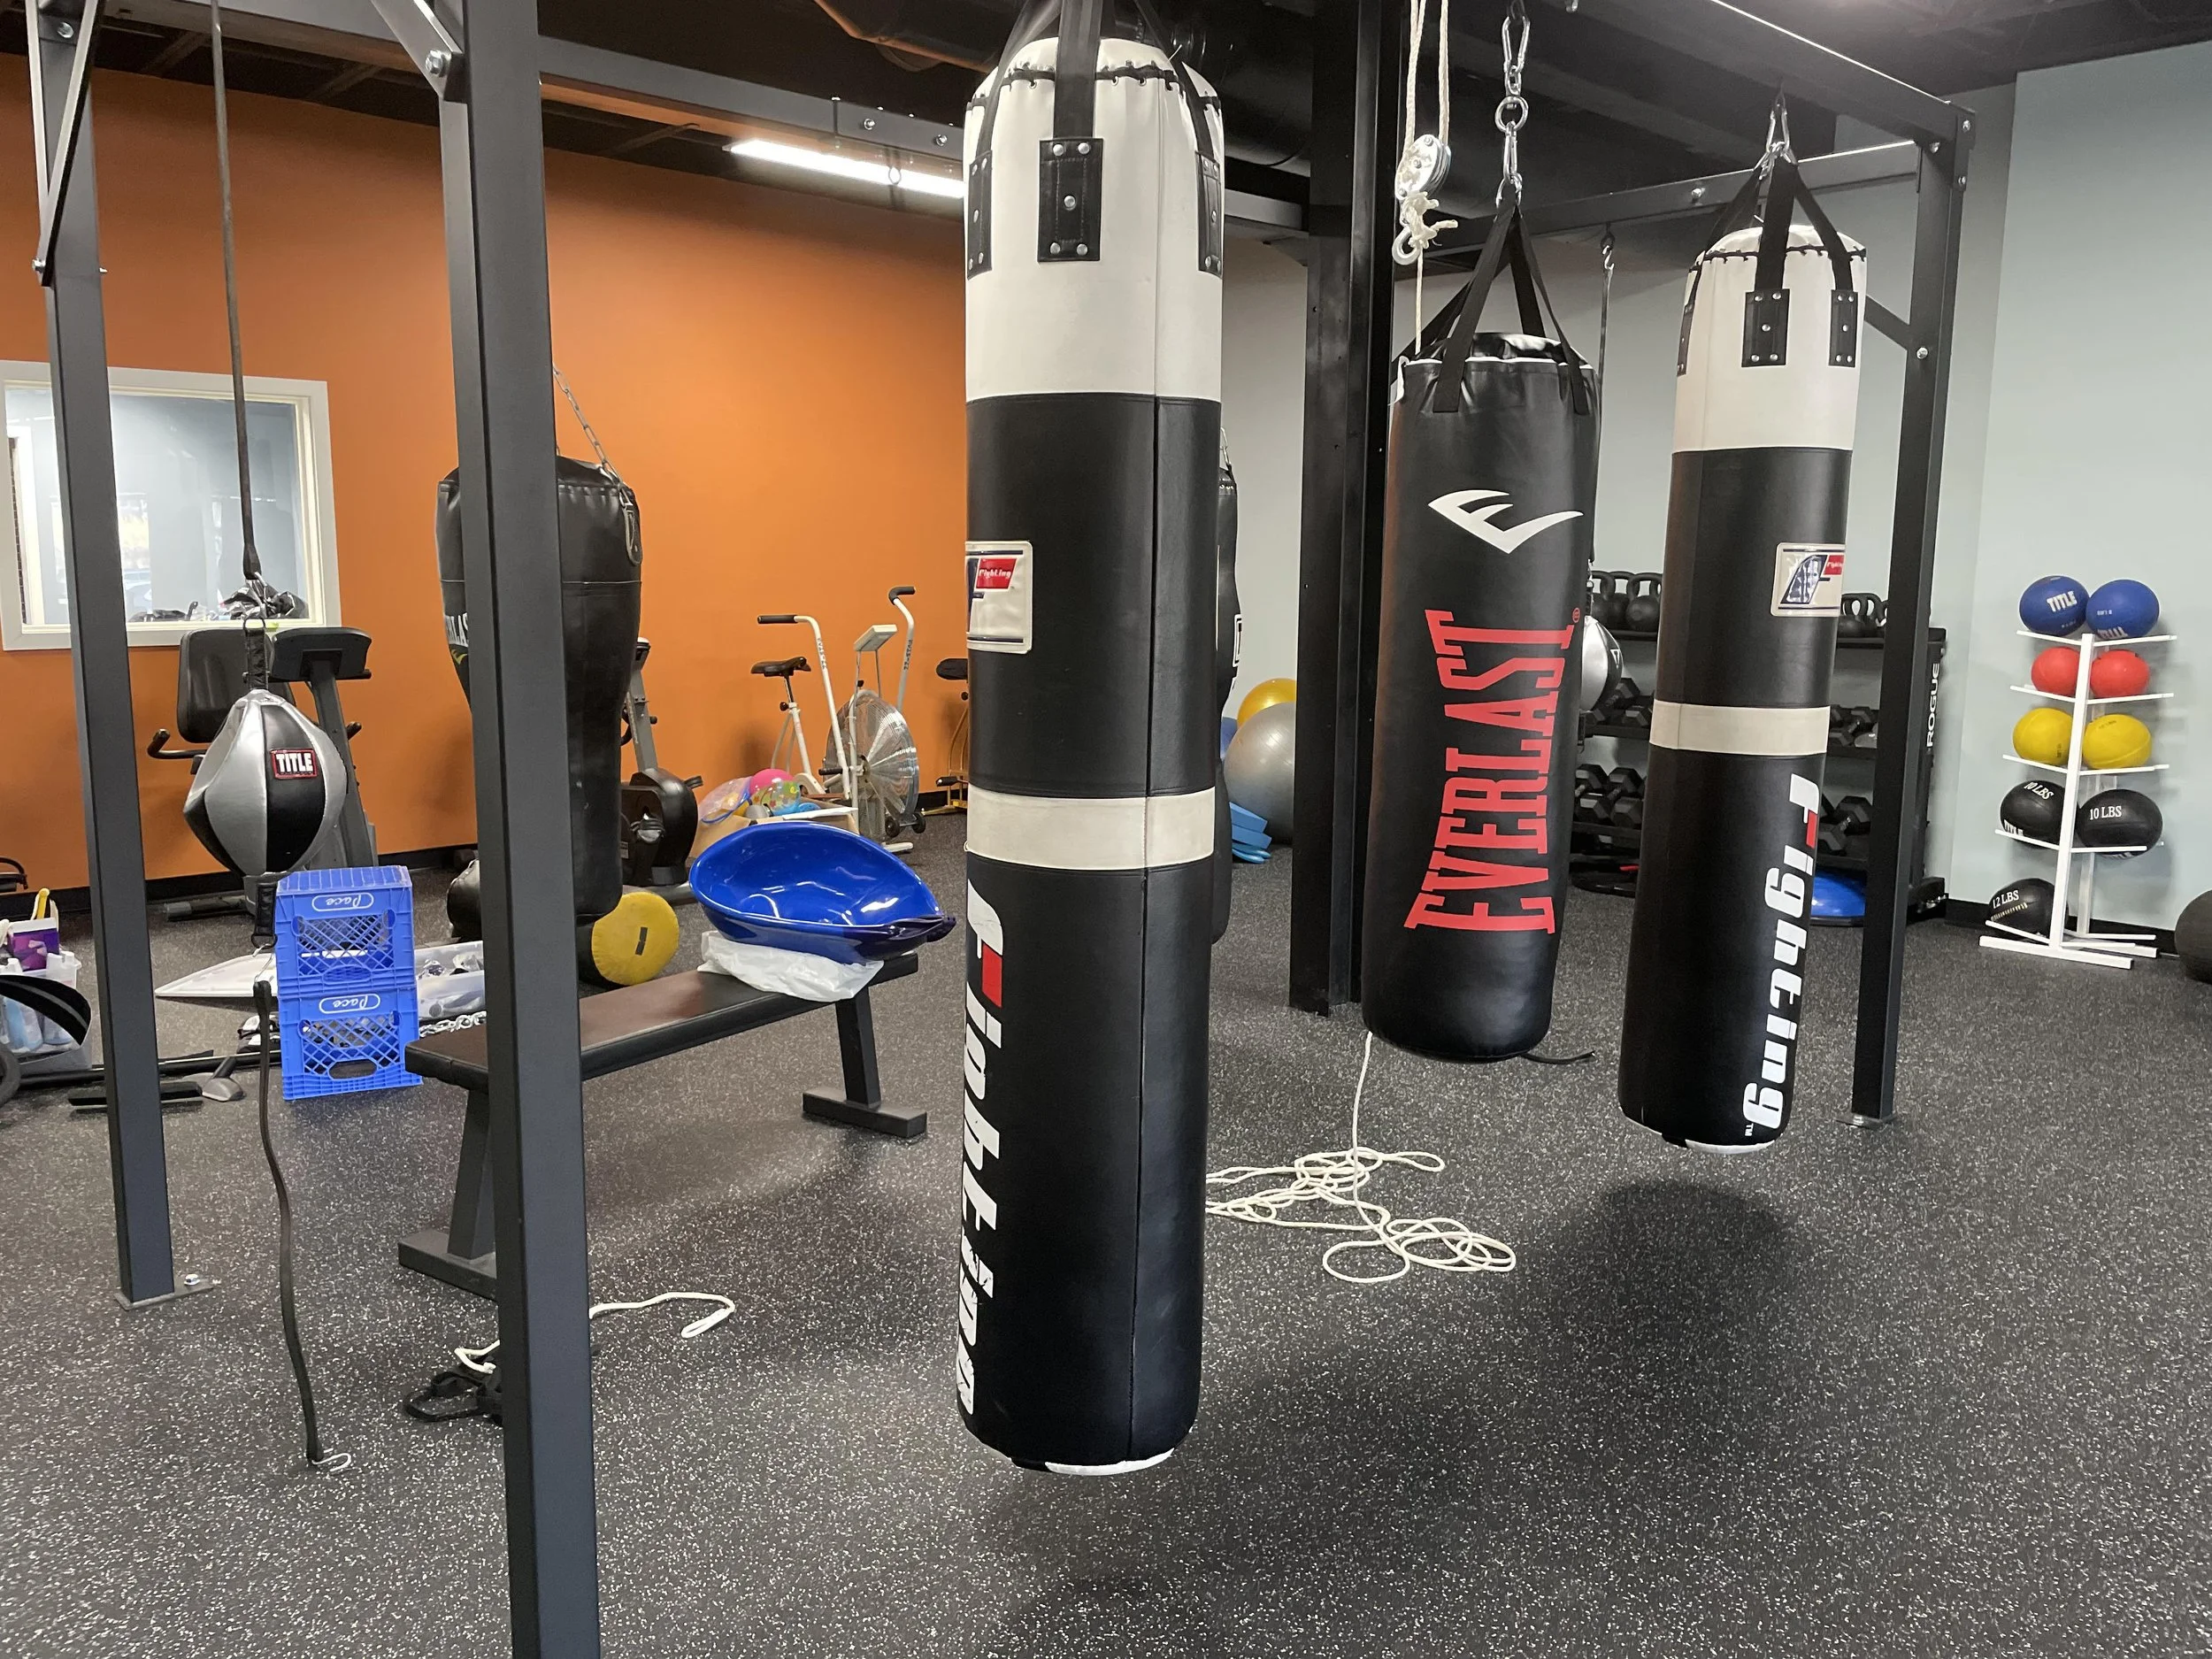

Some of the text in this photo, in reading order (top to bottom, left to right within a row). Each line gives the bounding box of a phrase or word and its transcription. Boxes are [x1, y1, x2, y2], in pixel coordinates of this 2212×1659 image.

[2047, 590, 2078, 612] TITLE
[1926, 663, 1940, 748] ROGUE
[275, 752, 313, 772] TITLE
[1403, 609, 1575, 934] EVERLAST
[2024, 781, 2054, 800] 10 LBS
[2089, 805, 2123, 820] 10 LBS
[1993, 889, 2020, 910] 12 LBS
[1743, 772, 1820, 1130] Fighting
